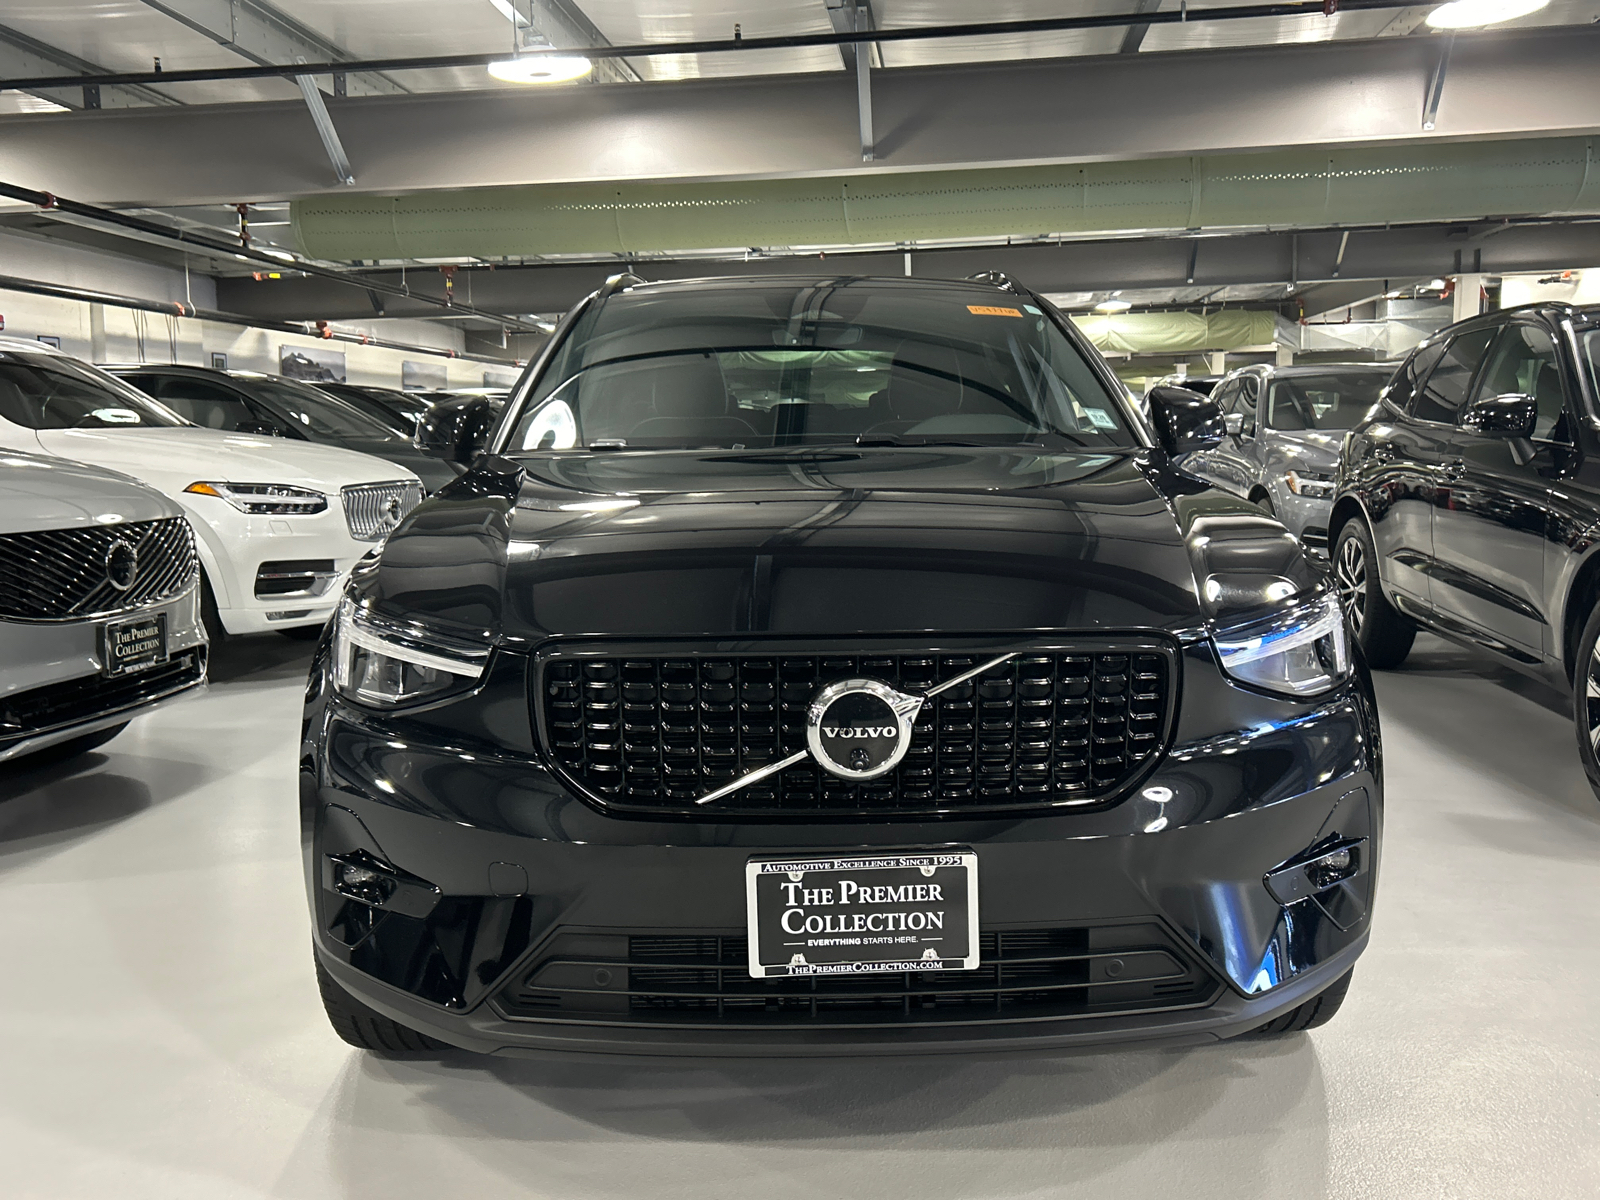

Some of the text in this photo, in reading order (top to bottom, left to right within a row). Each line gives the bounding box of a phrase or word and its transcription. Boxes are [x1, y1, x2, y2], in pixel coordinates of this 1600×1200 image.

[115, 626, 159, 644] THE PREMIER
[115, 638, 160, 657] COLLECTION
[822, 726, 897, 738] VOLVO
[764, 856, 961, 872] AUTOMOTIVE EXCELLENCE SINCE 1995
[780, 880, 944, 906] THE PREMIER
[780, 908, 944, 934] COLLECTION
[807, 935, 919, 947] EVERYTHING STARTS HERE.
